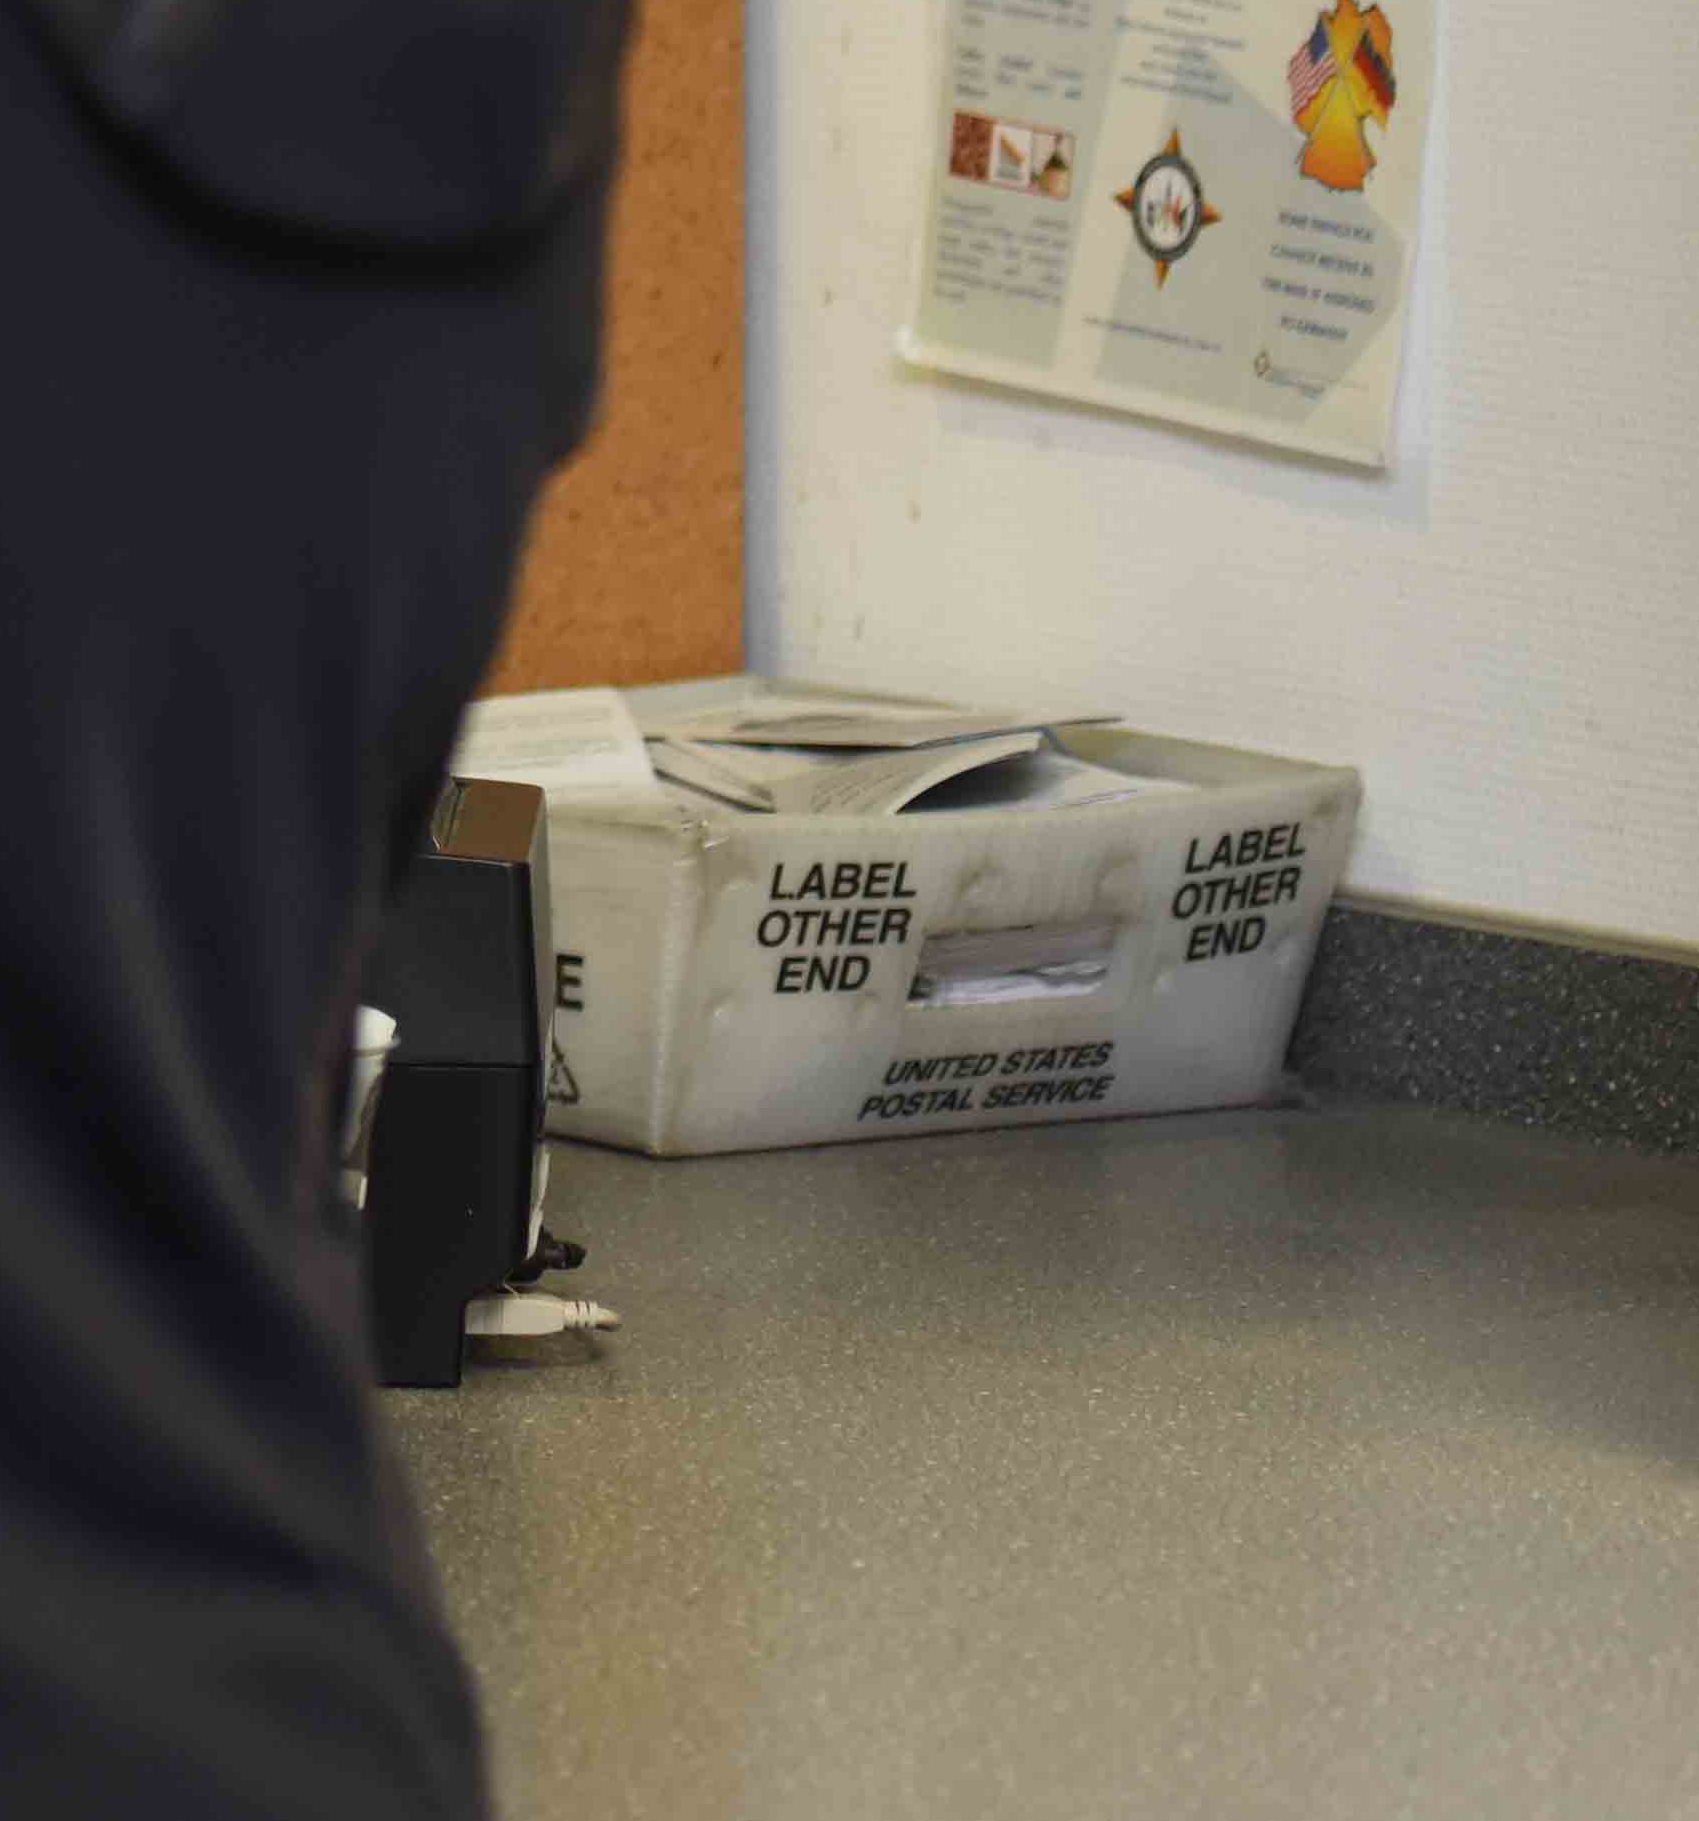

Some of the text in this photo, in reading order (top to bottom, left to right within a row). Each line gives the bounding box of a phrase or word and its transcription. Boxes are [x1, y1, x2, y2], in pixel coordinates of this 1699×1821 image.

[1183, 823, 1306, 874] LABEL
[770, 861, 918, 900] LABEL
[1172, 867, 1301, 920] OTHER
[757, 908, 912, 948] OTHER
[1184, 915, 1267, 963] END
[774, 955, 872, 994] END
[883, 1040, 1115, 1086] UNITED STATES
[856, 1074, 1116, 1122] POSTAL SERVICE
